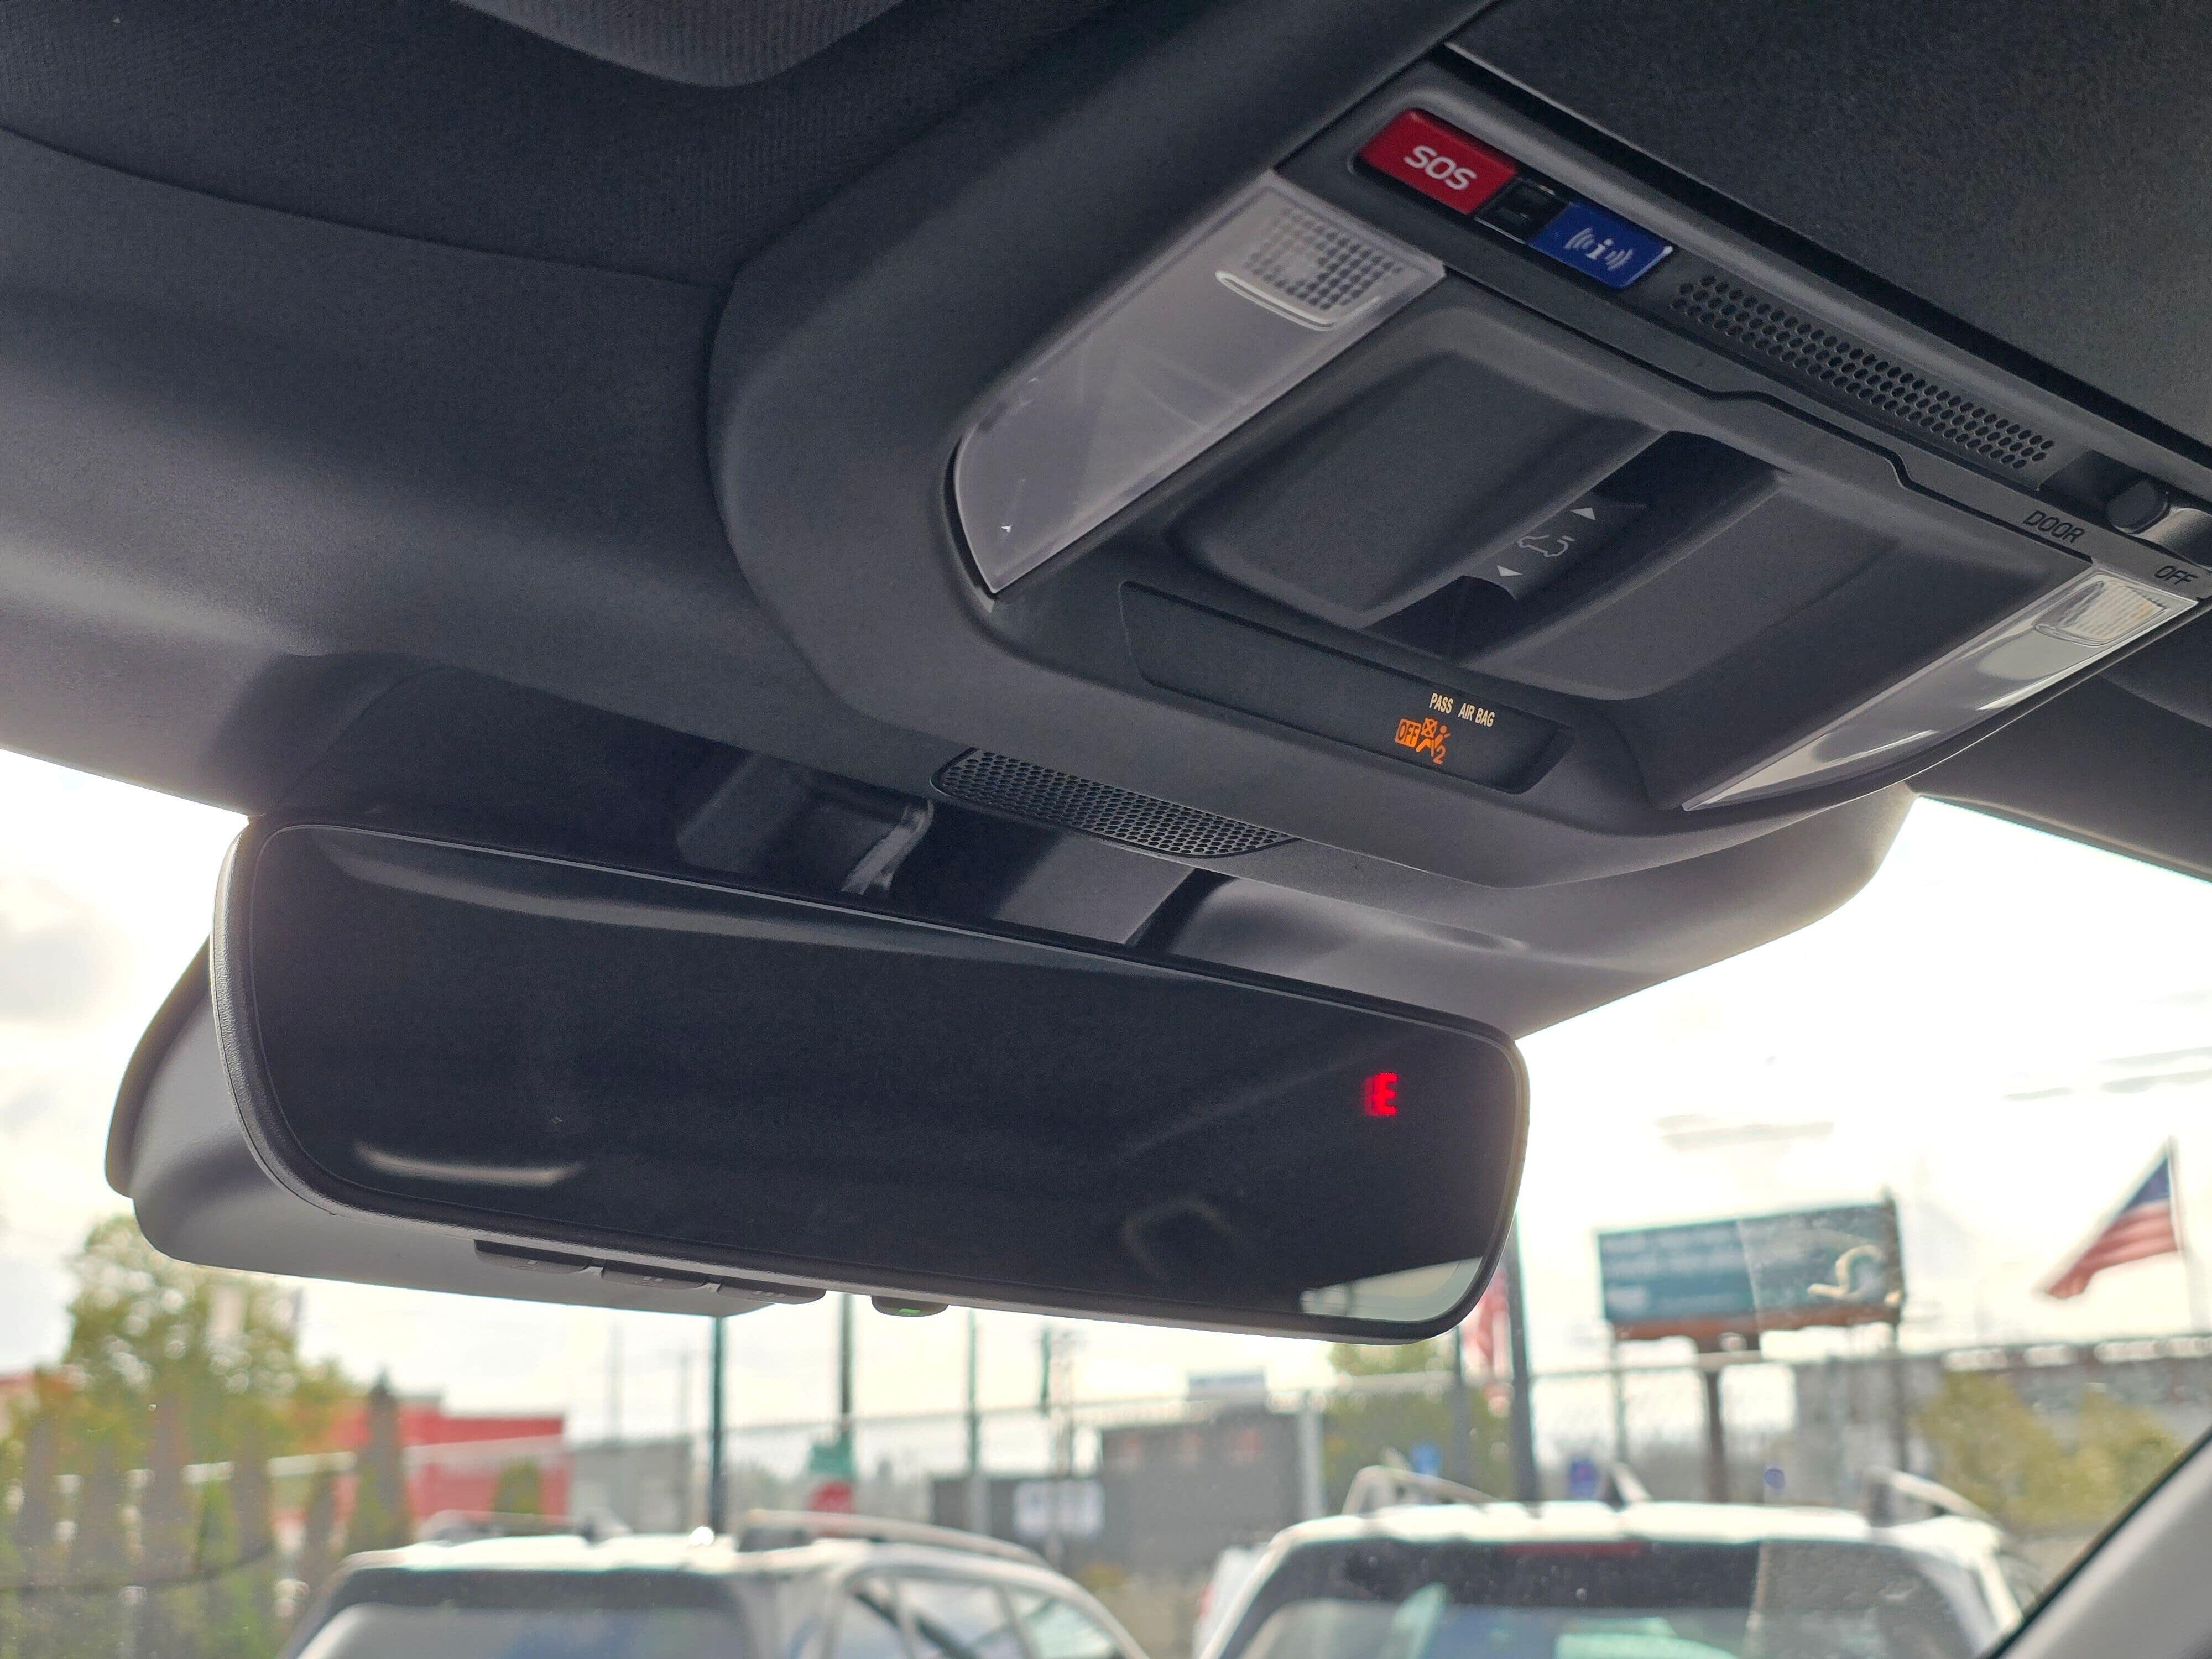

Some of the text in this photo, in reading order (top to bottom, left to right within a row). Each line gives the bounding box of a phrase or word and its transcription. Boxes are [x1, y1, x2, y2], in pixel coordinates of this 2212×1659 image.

[1404, 145, 1477, 190] SOS
[2022, 510, 2085, 543] DOOR
[2154, 565, 2198, 585] OFF
[1428, 693, 1495, 727] PASS AIR BAG
[1397, 721, 1420, 745] OFF
[1433, 745, 1446, 765] 2
[1368, 1072, 1399, 1116] E
